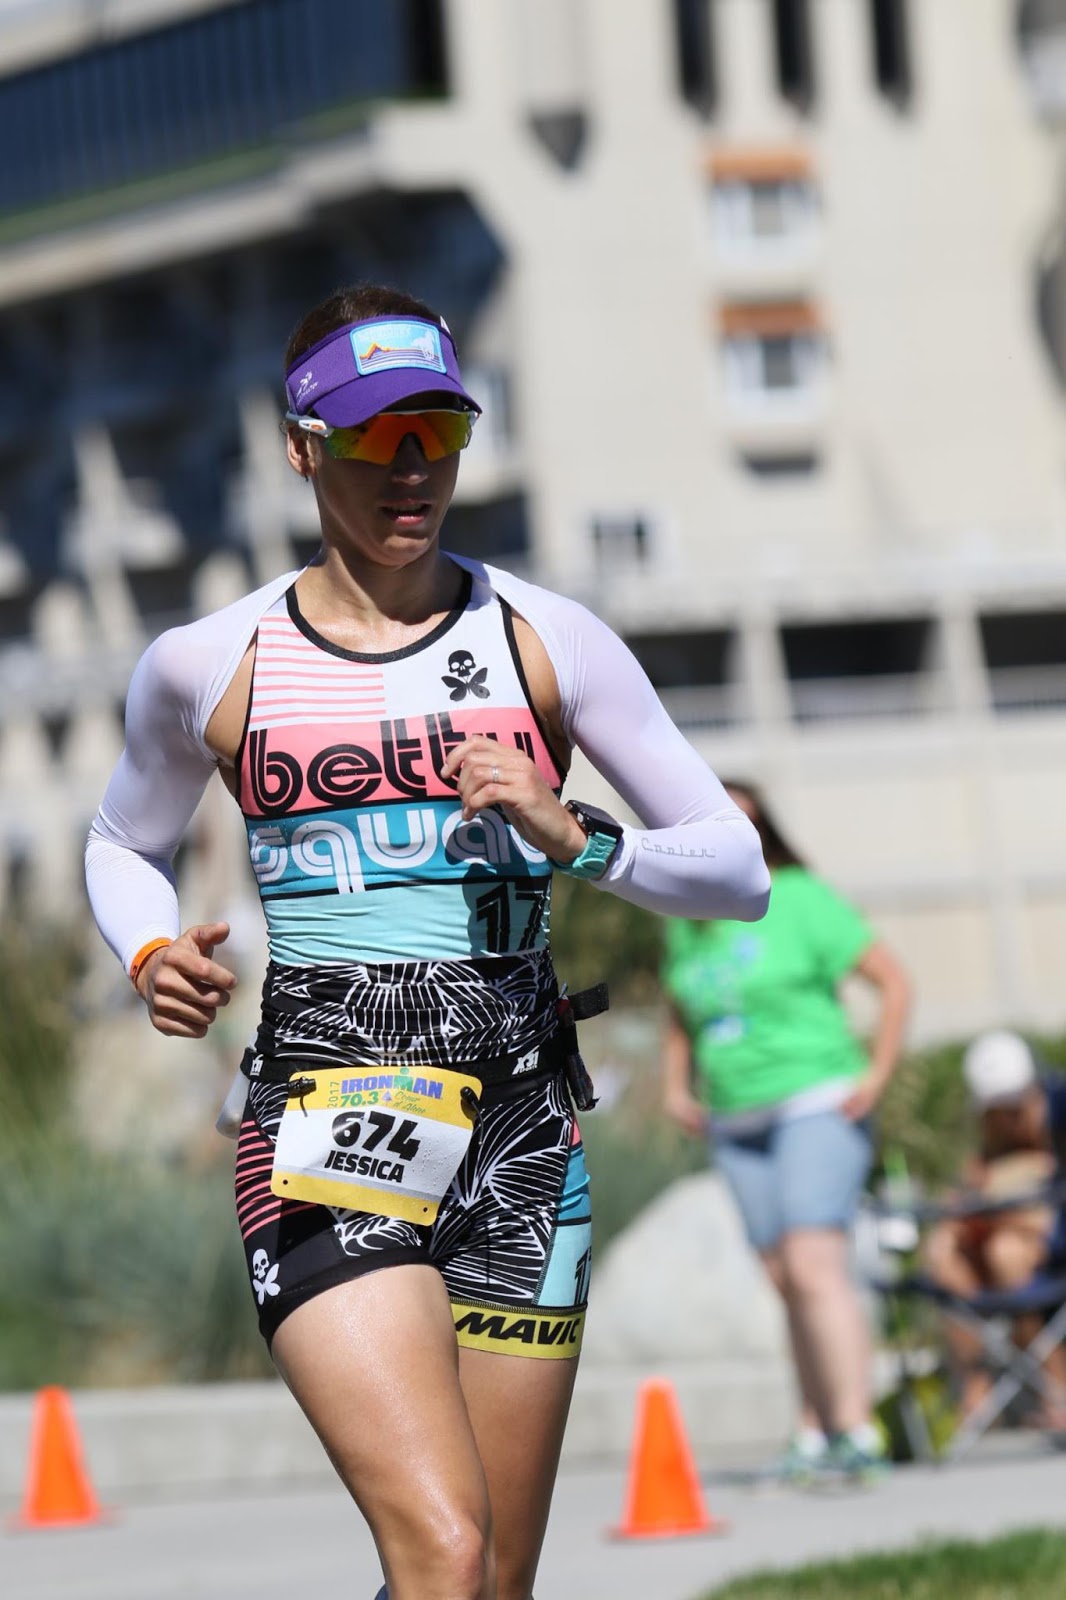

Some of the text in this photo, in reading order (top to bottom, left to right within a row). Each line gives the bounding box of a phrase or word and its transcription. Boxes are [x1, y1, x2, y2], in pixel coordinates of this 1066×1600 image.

[250, 711, 535, 814] bett
[475, 882, 546, 953] 17
[327, 1082, 340, 1108] 2017
[340, 1091, 379, 1108] 70.3
[341, 1067, 444, 1100] IRONMAN
[332, 1110, 421, 1161] 674
[324, 1150, 405, 1183] JESSICA
[454, 1311, 581, 1345] MAVIC
